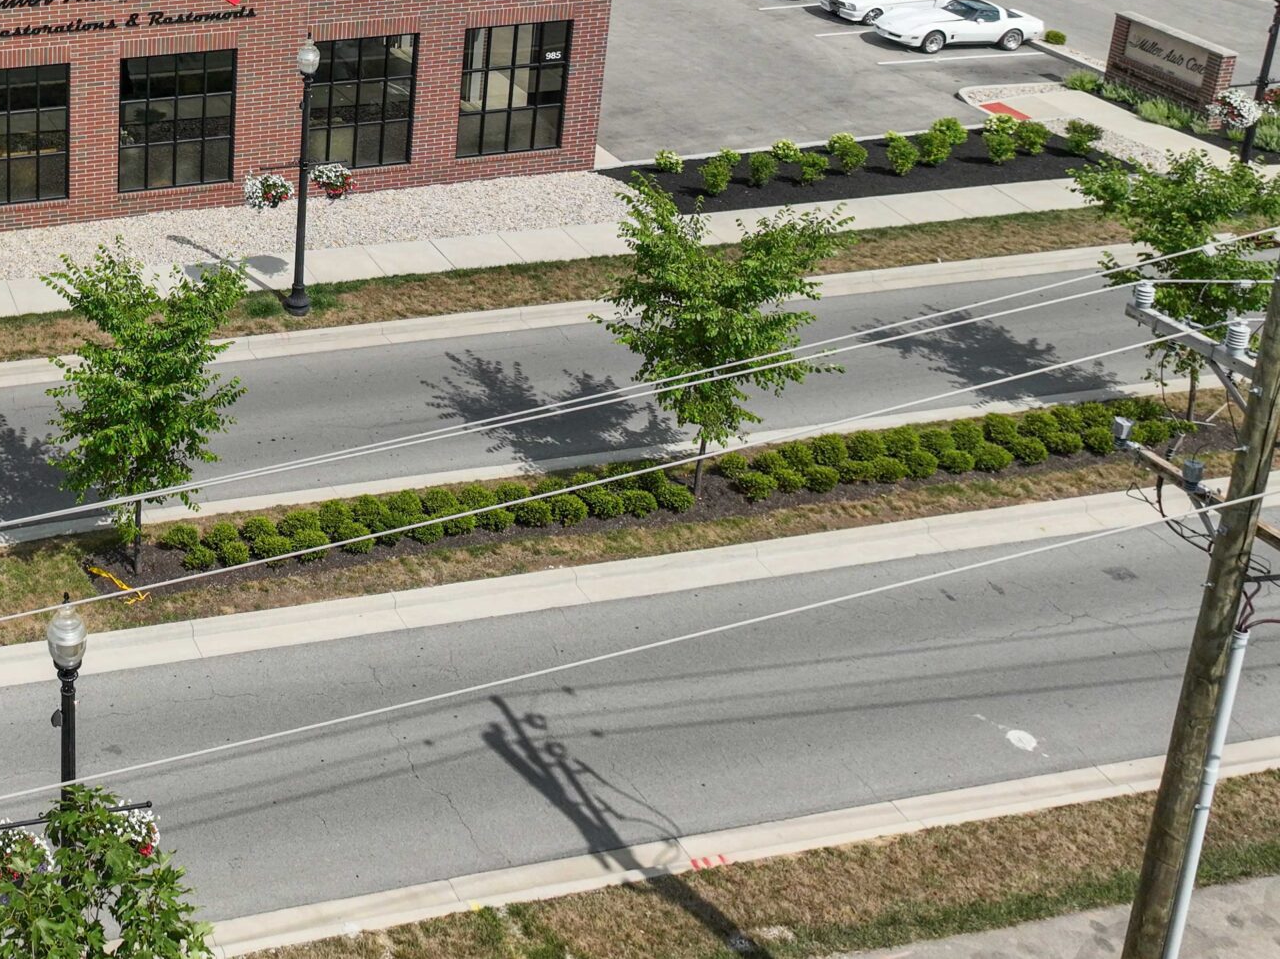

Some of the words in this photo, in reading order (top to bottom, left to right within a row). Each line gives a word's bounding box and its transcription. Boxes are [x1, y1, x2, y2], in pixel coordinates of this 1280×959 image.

[125, 12, 140, 27] &
[148, 6, 257, 27] Restomods
[545, 51, 562, 60] 985
[1137, 39, 1163, 57] Miller
[1163, 49, 1184, 66] Auto
[1185, 57, 1207, 74] Care
